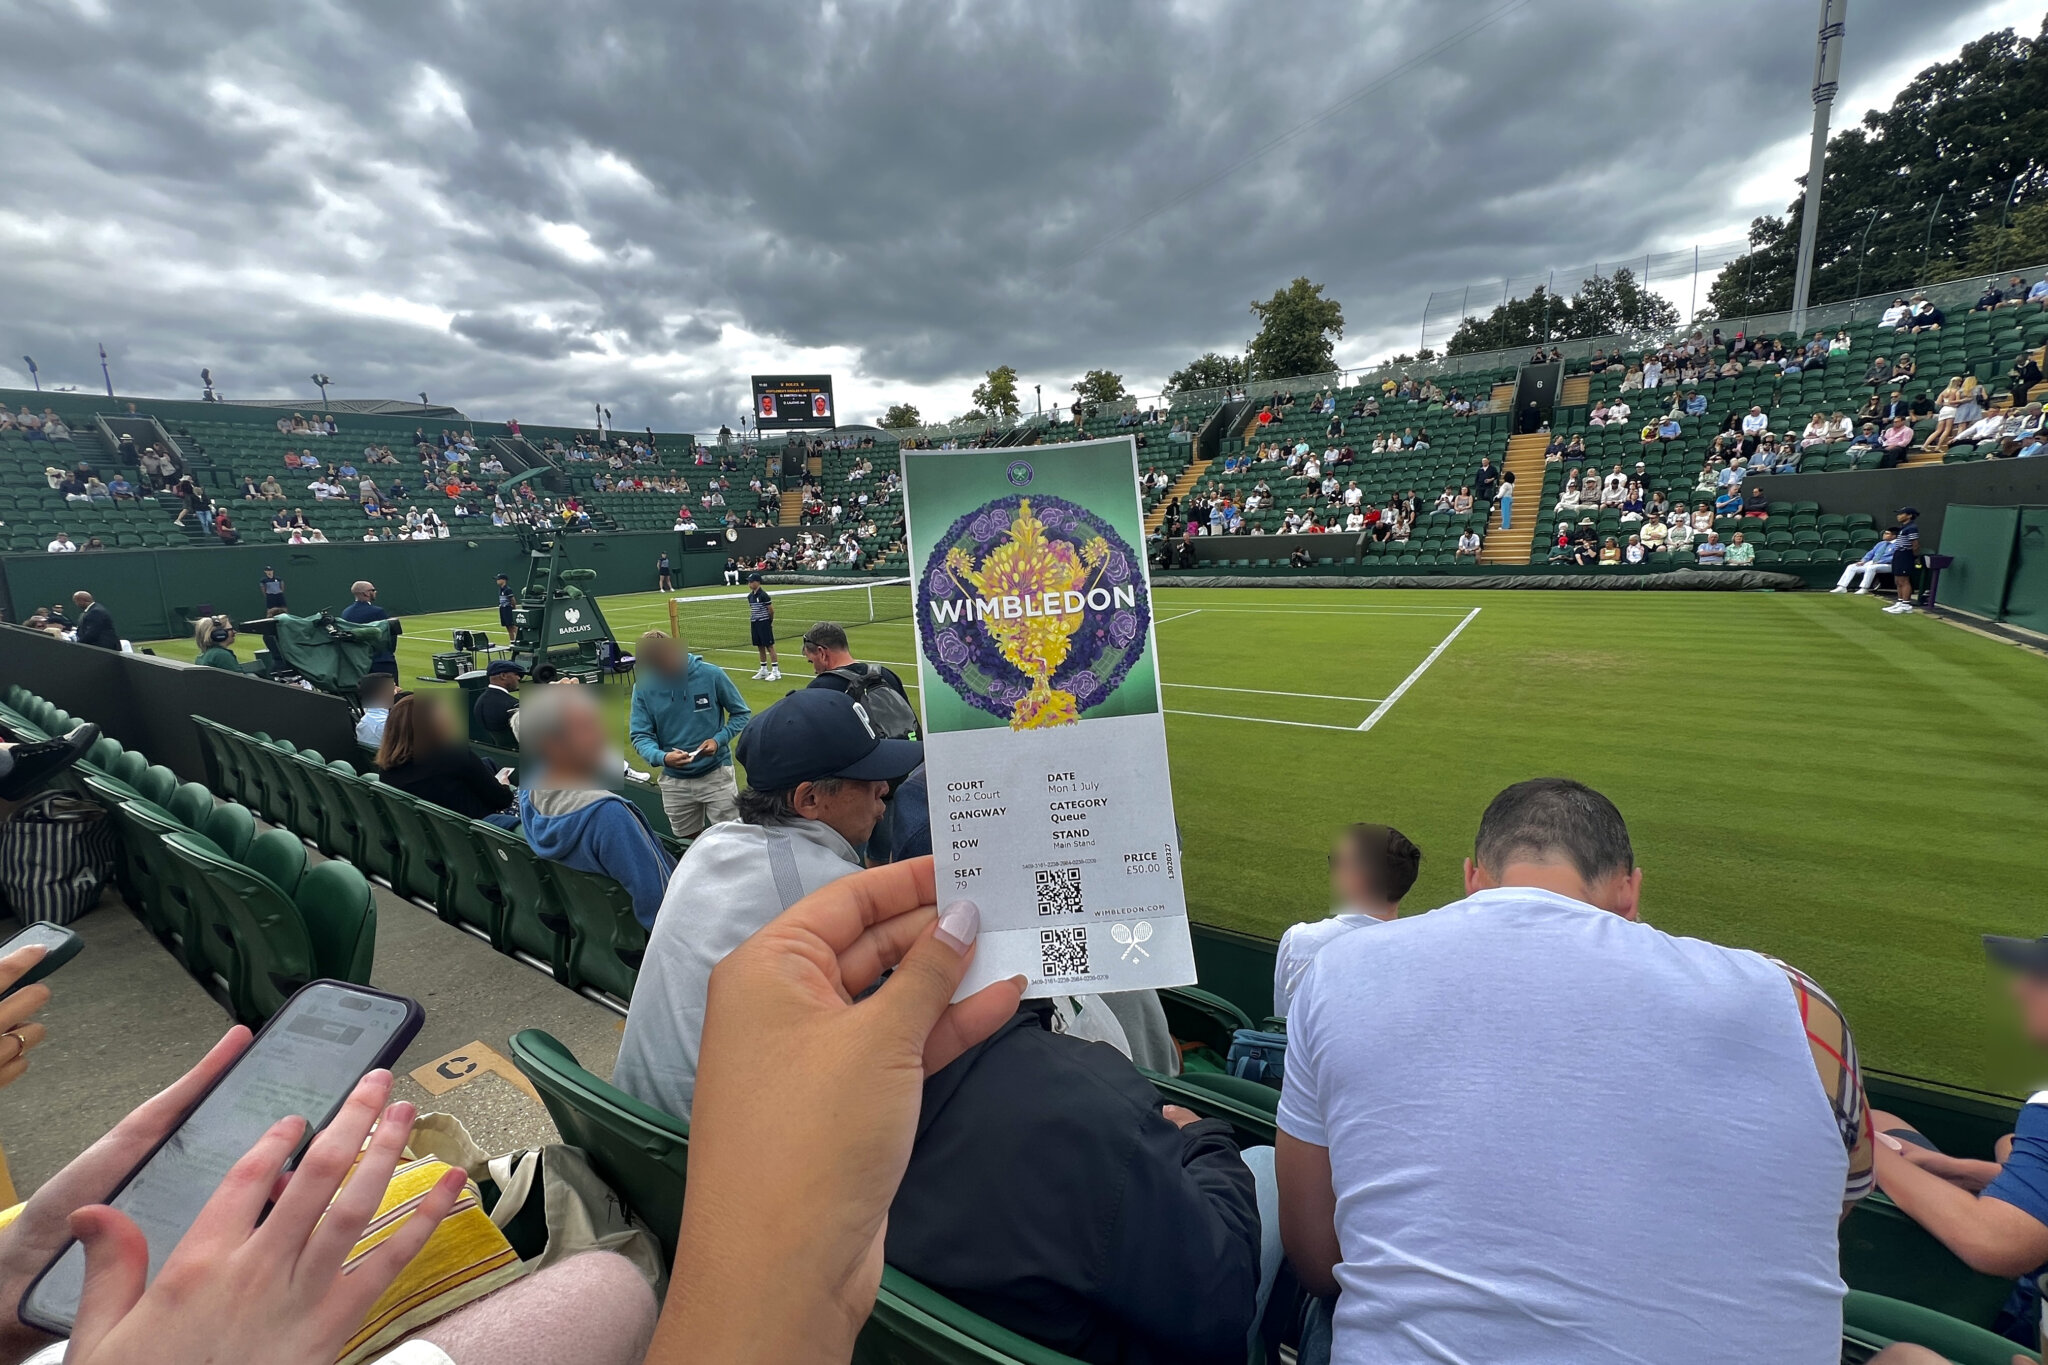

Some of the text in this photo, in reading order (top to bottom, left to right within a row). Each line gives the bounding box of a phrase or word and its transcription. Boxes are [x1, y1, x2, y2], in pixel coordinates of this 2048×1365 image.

[1536, 380, 1543, 389] 6
[929, 584, 1136, 624] WIMBLEDON
[559, 624, 591, 635] BARCLAYS
[1047, 772, 1076, 783] DATE
[947, 780, 985, 792] COURT
[1048, 781, 1100, 793] Mon 1 July
[948, 790, 1001, 803] No.2 Court
[1049, 798, 1108, 811] CATEGORY
[949, 807, 1007, 820] GANGWAY
[1050, 813, 1087, 824] Queue
[951, 823, 963, 832] 11
[1052, 828, 1090, 840] STAND
[952, 839, 979, 849] ROW
[1053, 838, 1096, 849] Main Stand
[952, 852, 961, 861] D
[1123, 852, 1157, 863] PRICE
[1164, 843, 1175, 880] 13020327
[954, 867, 982, 878] SEAT
[1126, 863, 1160, 875] £50.00
[73, 866, 98, 887] A
[955, 880, 968, 890] 79
[1094, 904, 1165, 917] WIMBLEDON.COM
